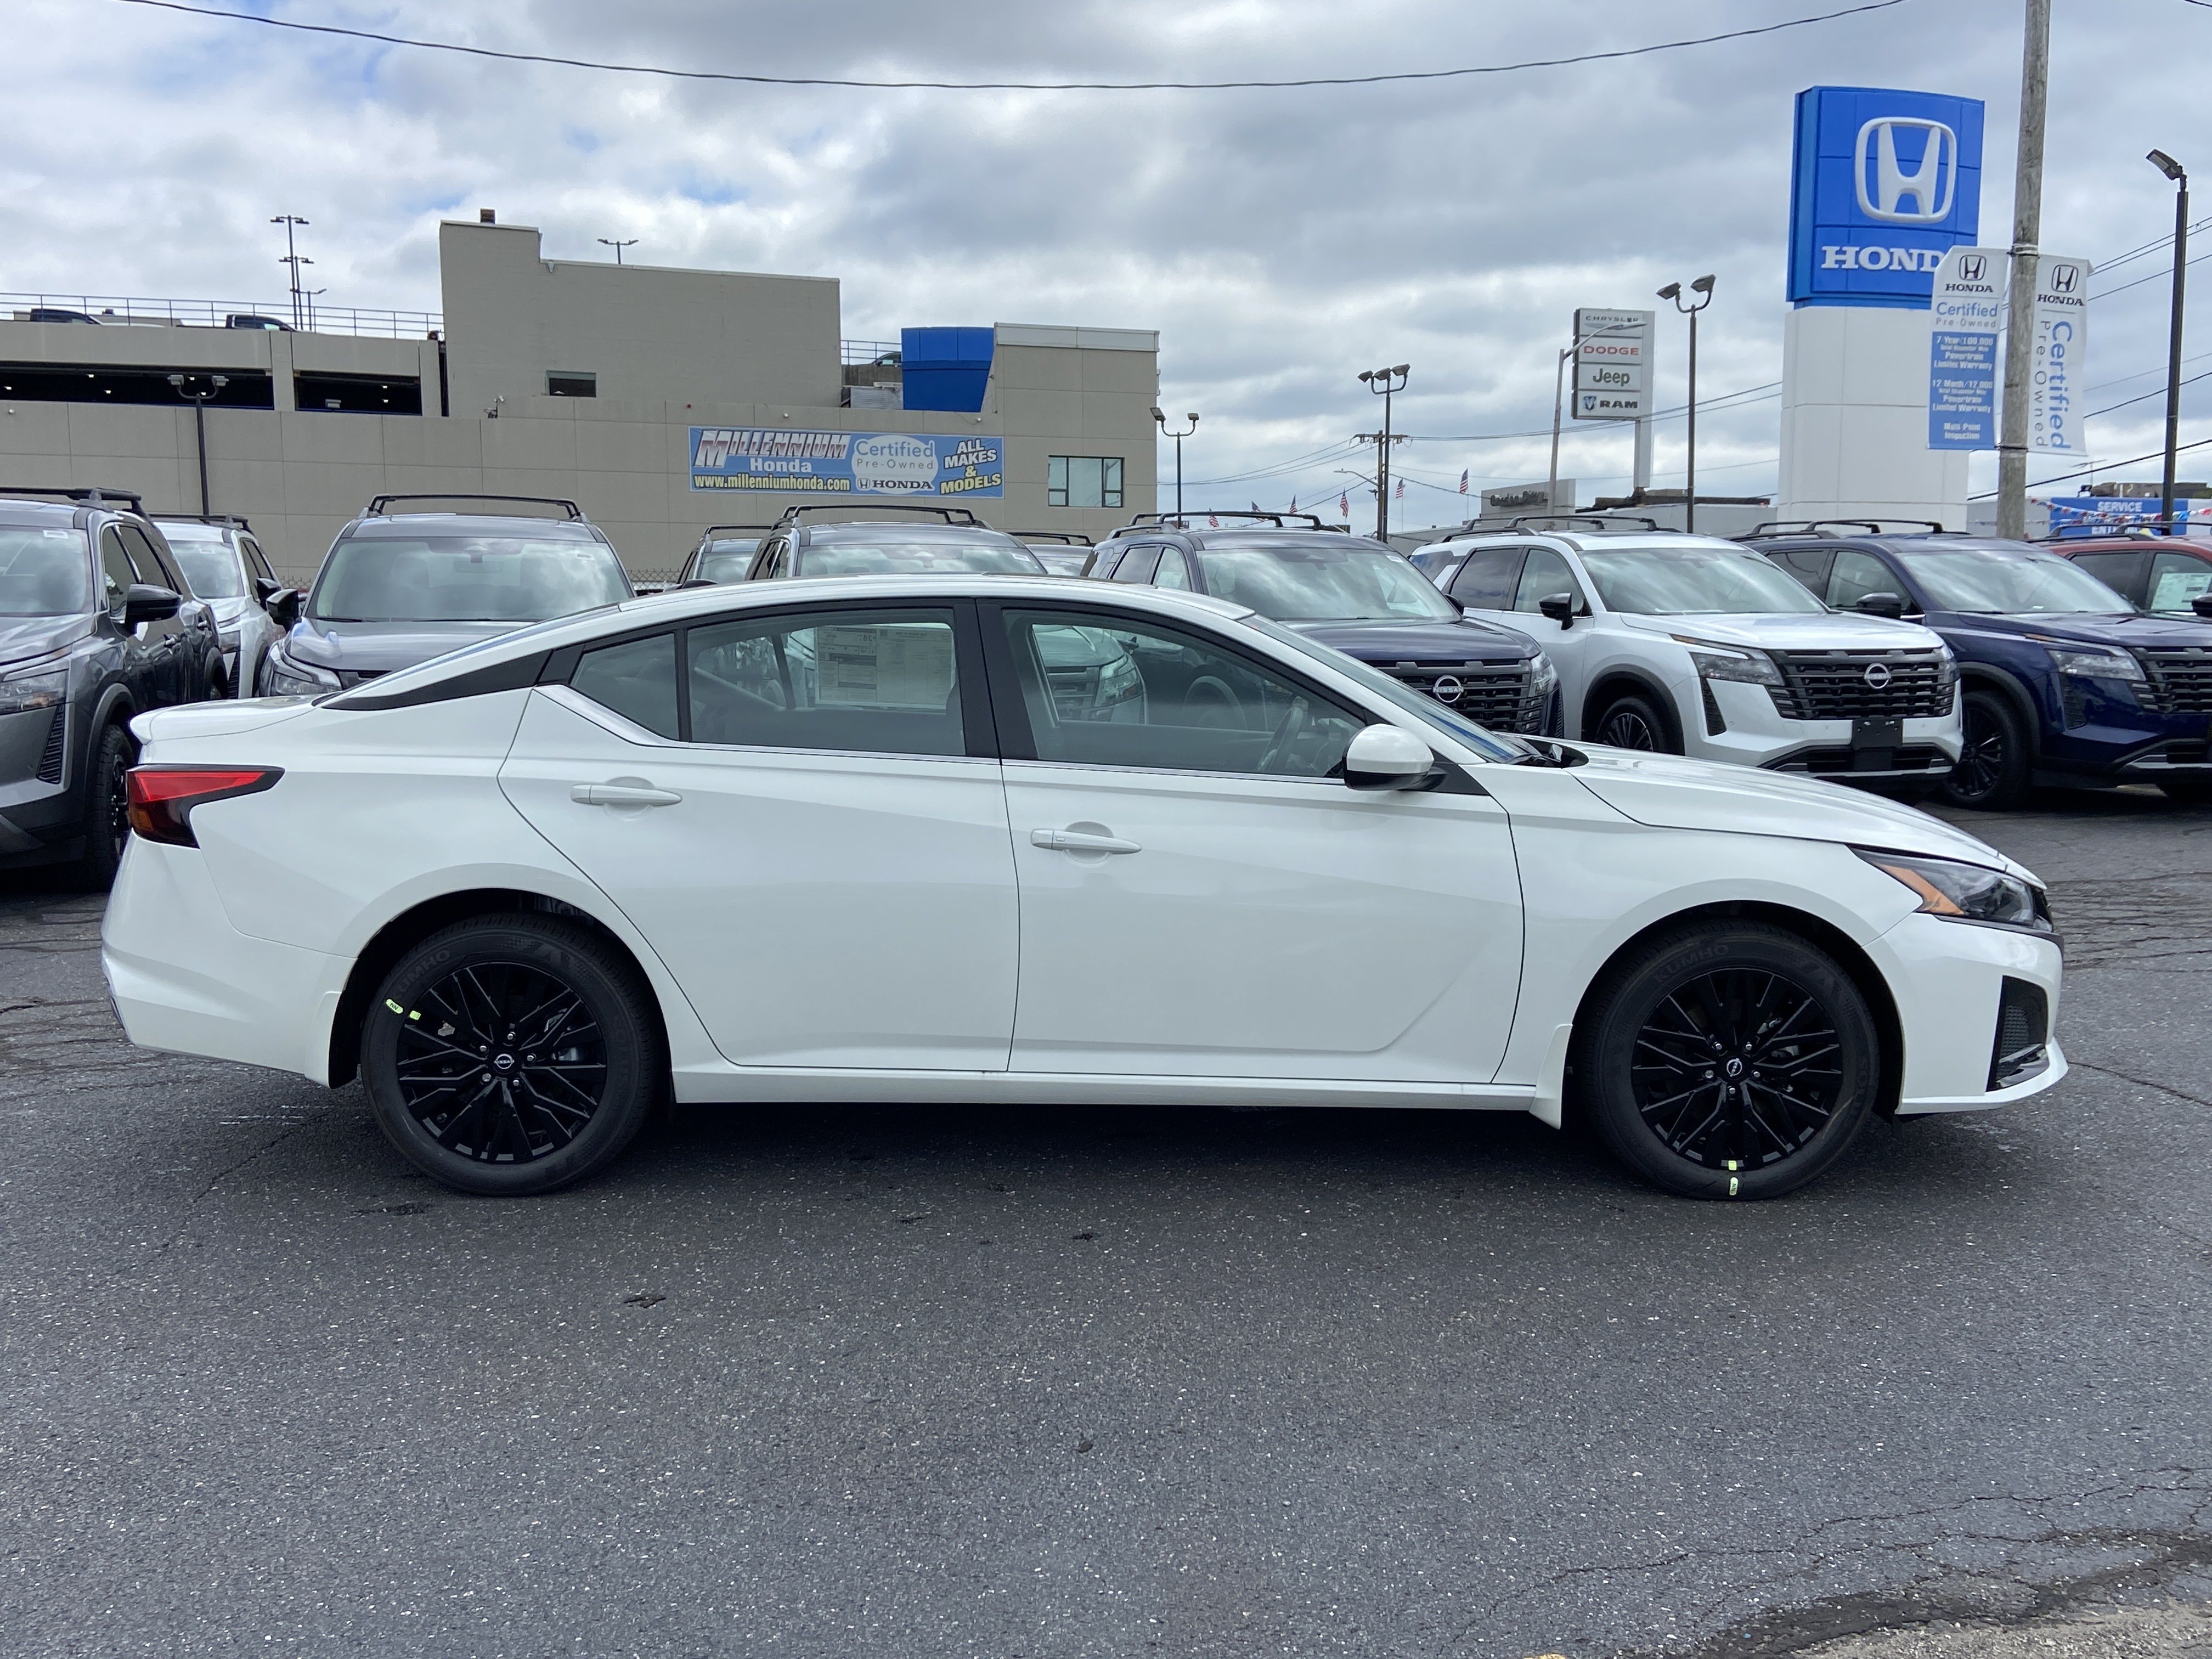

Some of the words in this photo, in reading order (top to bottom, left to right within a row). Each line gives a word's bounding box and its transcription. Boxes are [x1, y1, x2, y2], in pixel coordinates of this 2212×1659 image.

[1821, 246, 1946, 273] HOND
[1945, 283, 1994, 292] HONDA
[2036, 294, 2085, 307] HONDA
[1937, 302, 1998, 317] Certified
[1936, 317, 1996, 328] Pre-Owned
[1937, 335, 1942, 344] 7
[1583, 346, 1639, 356] DODGE
[1593, 368, 1630, 386] Jeep
[1932, 379, 1942, 387] 12
[2034, 320, 2051, 447] Pre-Owned
[2049, 321, 2073, 448] Certified
[1600, 400, 1638, 409] RAM
[693, 430, 851, 468] MILLENNIUM
[856, 441, 933, 458] Certified
[957, 439, 984, 455] ALL
[750, 457, 812, 472] Honda
[857, 458, 933, 470] Pre-Owned
[944, 449, 997, 469] MAKES
[964, 465, 977, 477] &
[694, 473, 850, 491] www.millenniumhonda.com
[872, 479, 933, 489] HONDA
[940, 473, 1002, 495] MODELS
[2097, 501, 2142, 512] SERVICE
[1655, 944, 1730, 985] KUMHO
